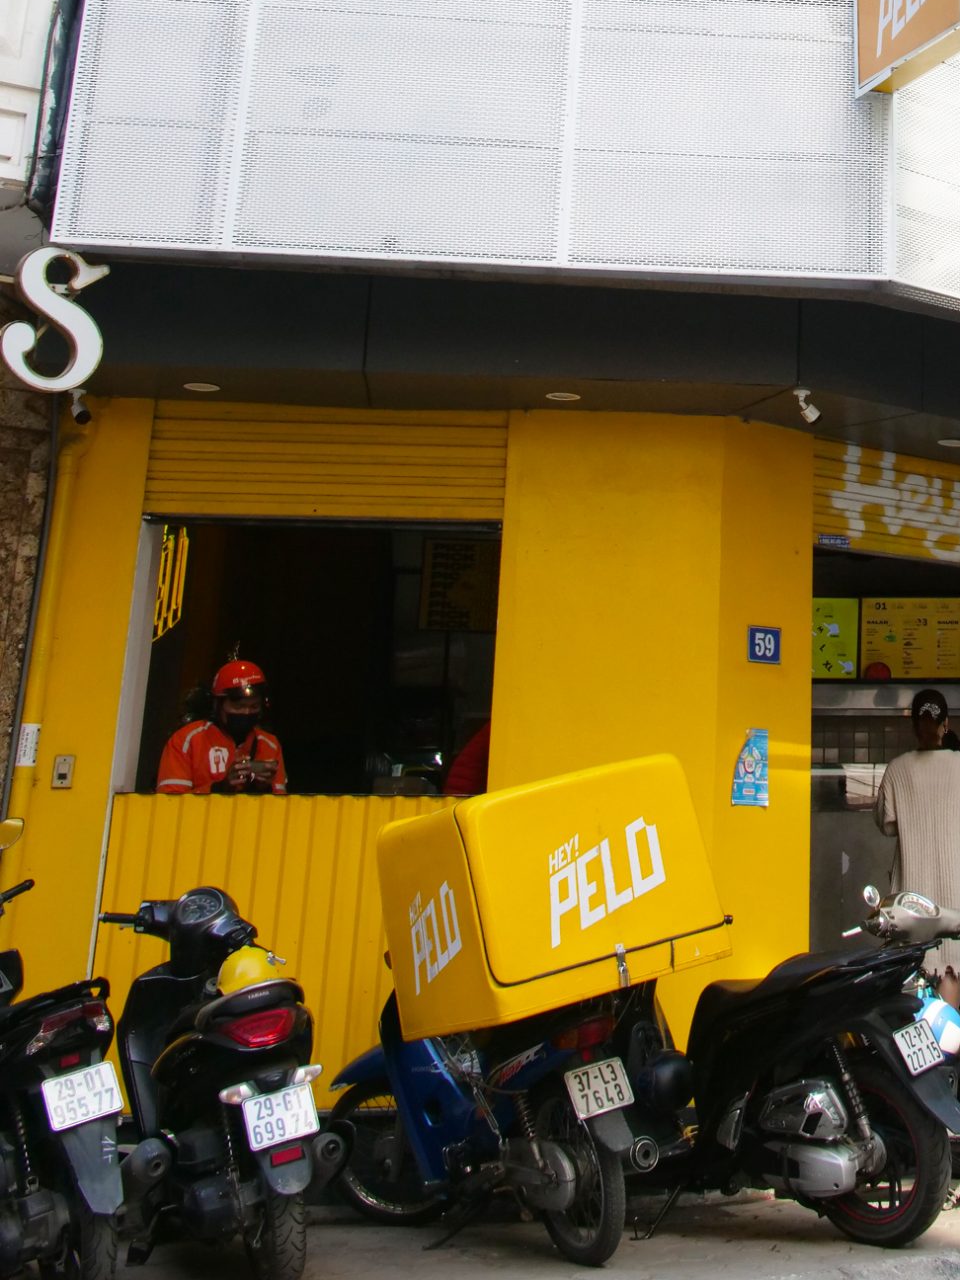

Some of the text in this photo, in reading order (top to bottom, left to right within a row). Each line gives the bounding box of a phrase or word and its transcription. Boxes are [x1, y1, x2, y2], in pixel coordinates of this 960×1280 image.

[1, 246, 111, 392] S
[754, 632, 775, 657] 59
[548, 832, 579, 875] HEY!
[549, 816, 666, 950] PELO
[409, 891, 423, 927] HEY!
[411, 880, 463, 996] PELO
[901, 1023, 930, 1050] 12-P1
[907, 1041, 941, 1072] 227.15
[573, 1063, 618, 1094] 37-L3
[53, 1087, 115, 1125] 955.77
